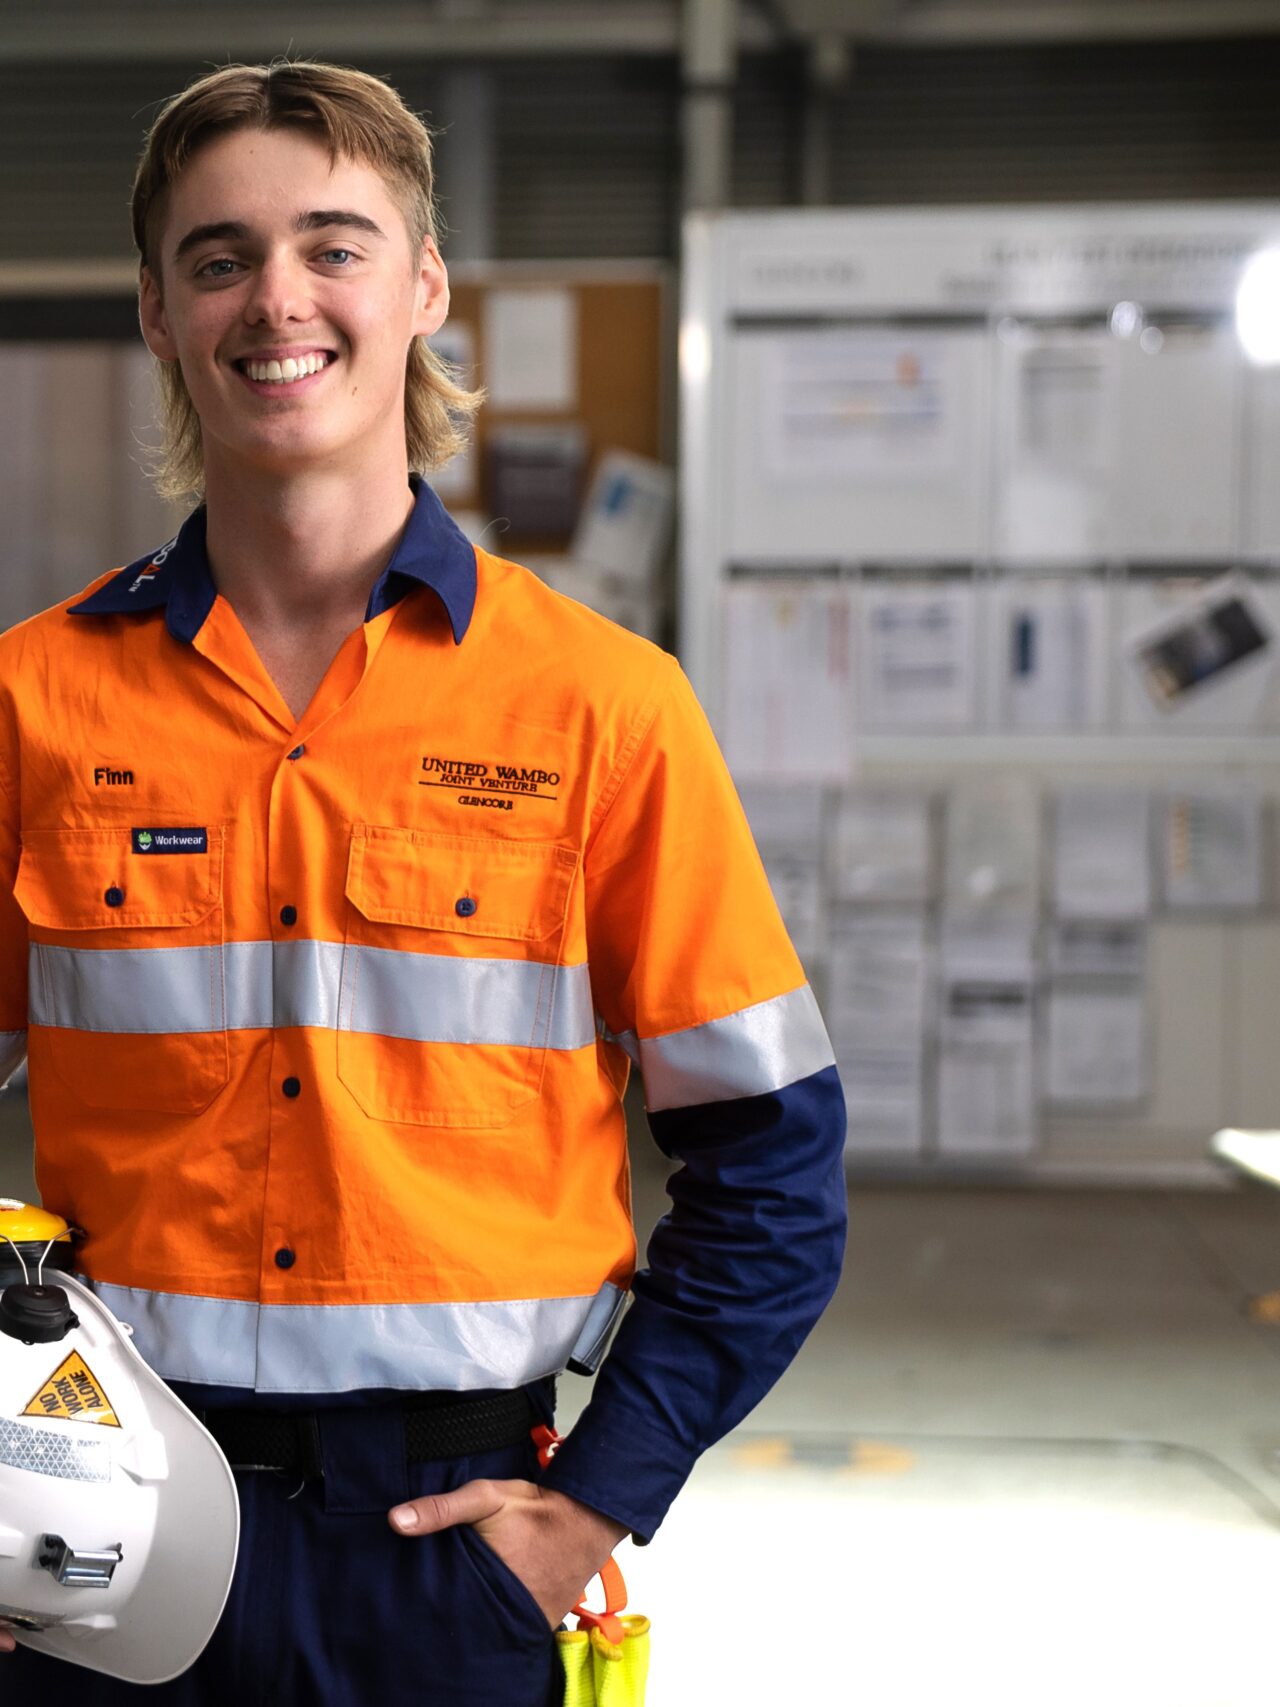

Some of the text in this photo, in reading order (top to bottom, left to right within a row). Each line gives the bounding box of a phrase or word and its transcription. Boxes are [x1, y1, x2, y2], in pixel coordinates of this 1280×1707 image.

[94, 768, 134, 785] Finn
[422, 757, 560, 786] UNITED WAMBO
[439, 773, 538, 793] JOINT VENTURE
[154, 835, 203, 845] Workwear
[51, 1376, 84, 1416] WORK
[69, 1369, 104, 1409] ALONE
[39, 1392, 62, 1413] NO
